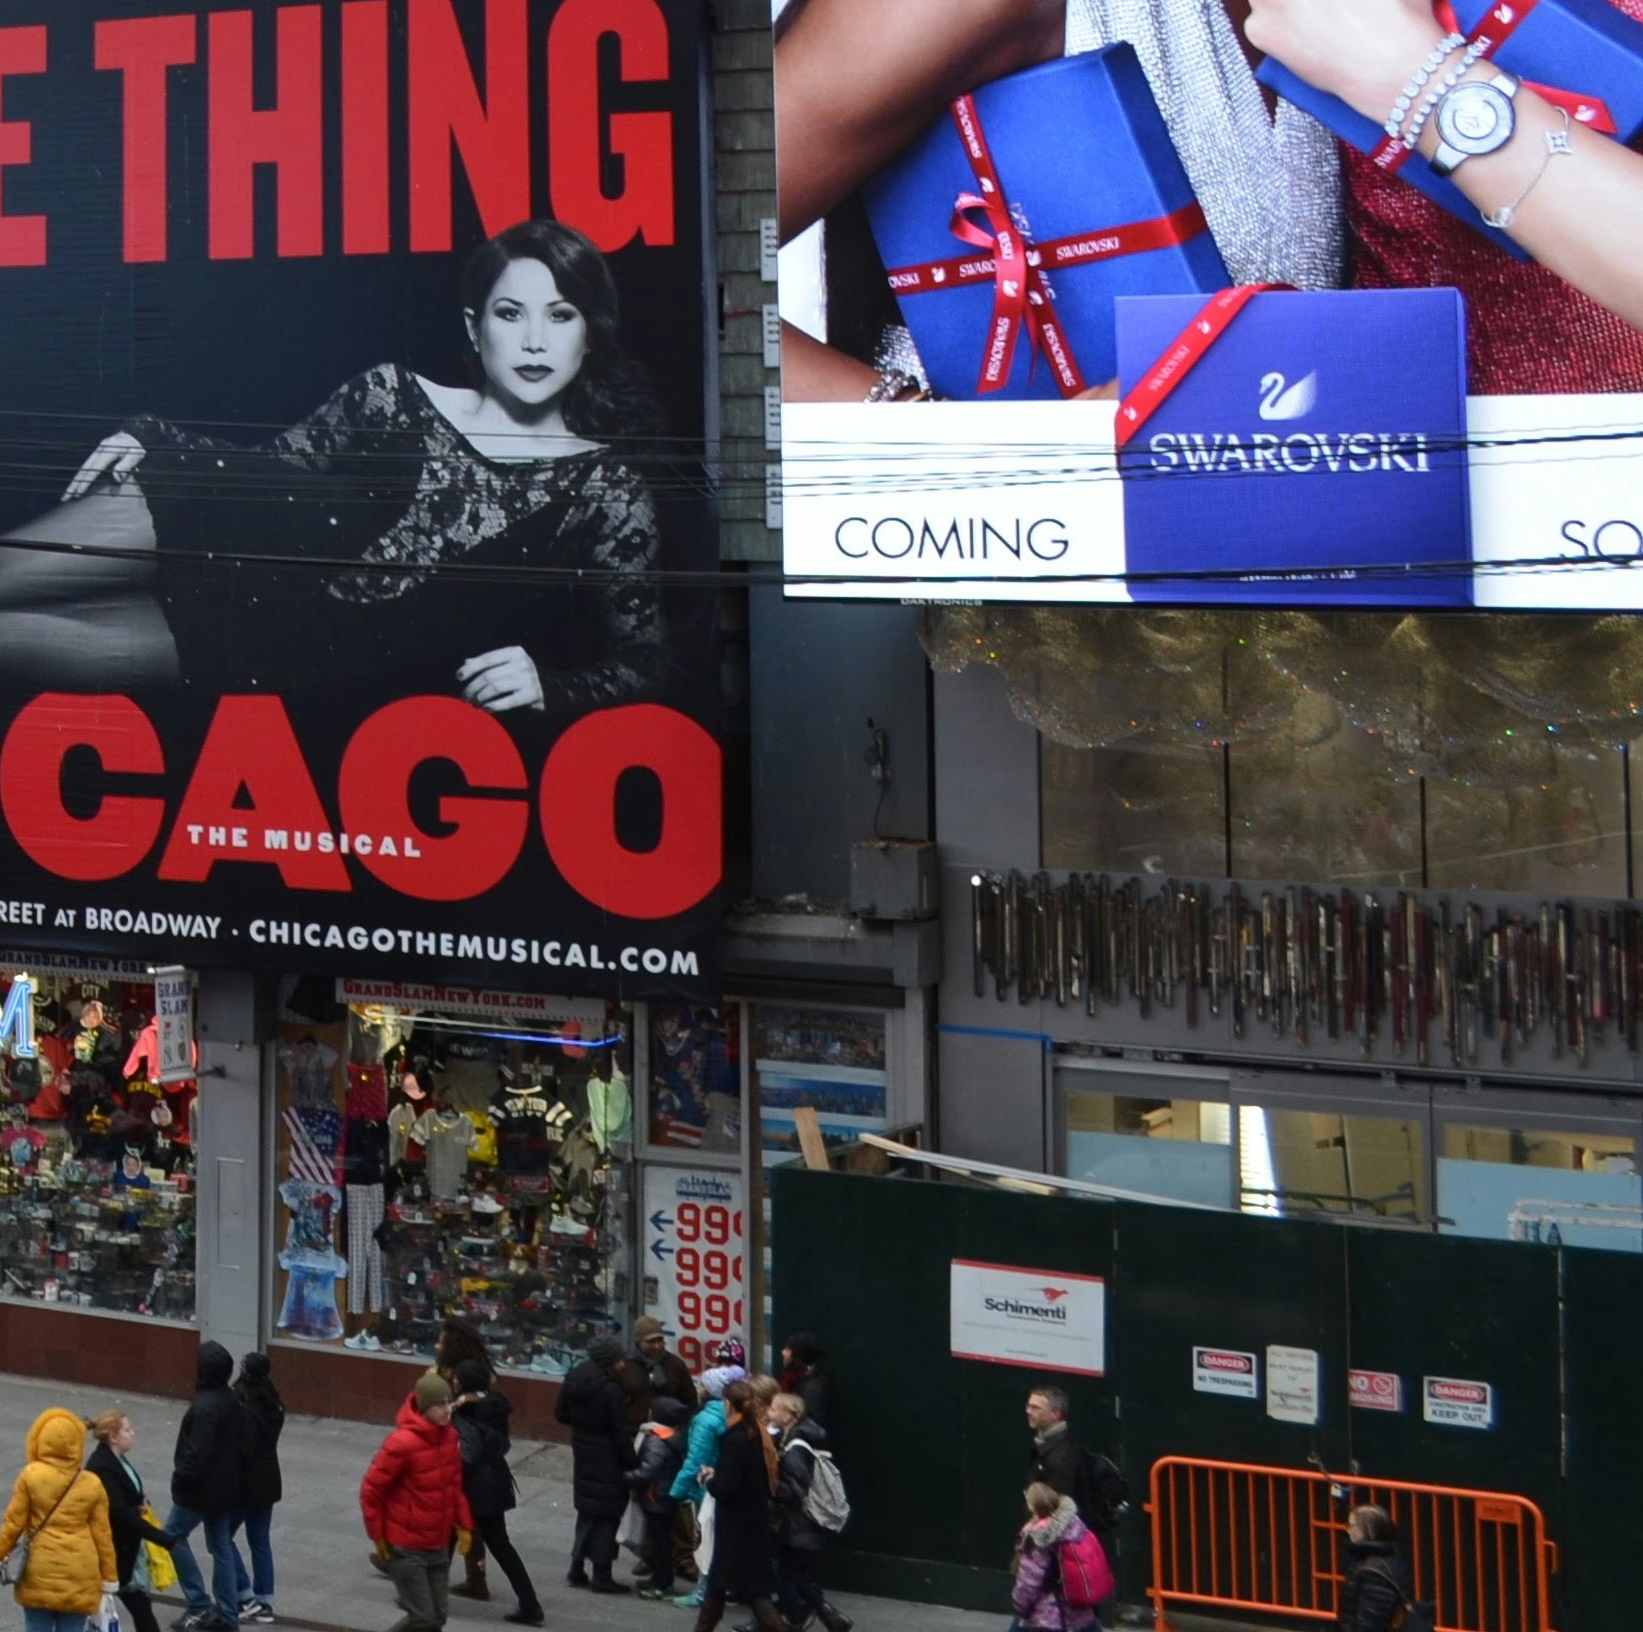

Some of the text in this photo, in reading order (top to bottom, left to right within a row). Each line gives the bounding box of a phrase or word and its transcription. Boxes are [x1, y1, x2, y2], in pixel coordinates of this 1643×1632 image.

[1148, 431, 1430, 474] SWAROVSKI
[834, 517, 1069, 561] COMING
[188, 825, 422, 858] THE MUSICAL
[54, 910, 77, 929] AT
[85, 909, 221, 939] BROADWAY
[249, 919, 700, 976] CHICAGOTHEMUSICAL.COM
[161, 999, 188, 1016] SLAM
[984, 1296, 1067, 1321] Schimenti
[1201, 1354, 1247, 1368] DANGER
[1433, 1384, 1480, 1398] DANGER
